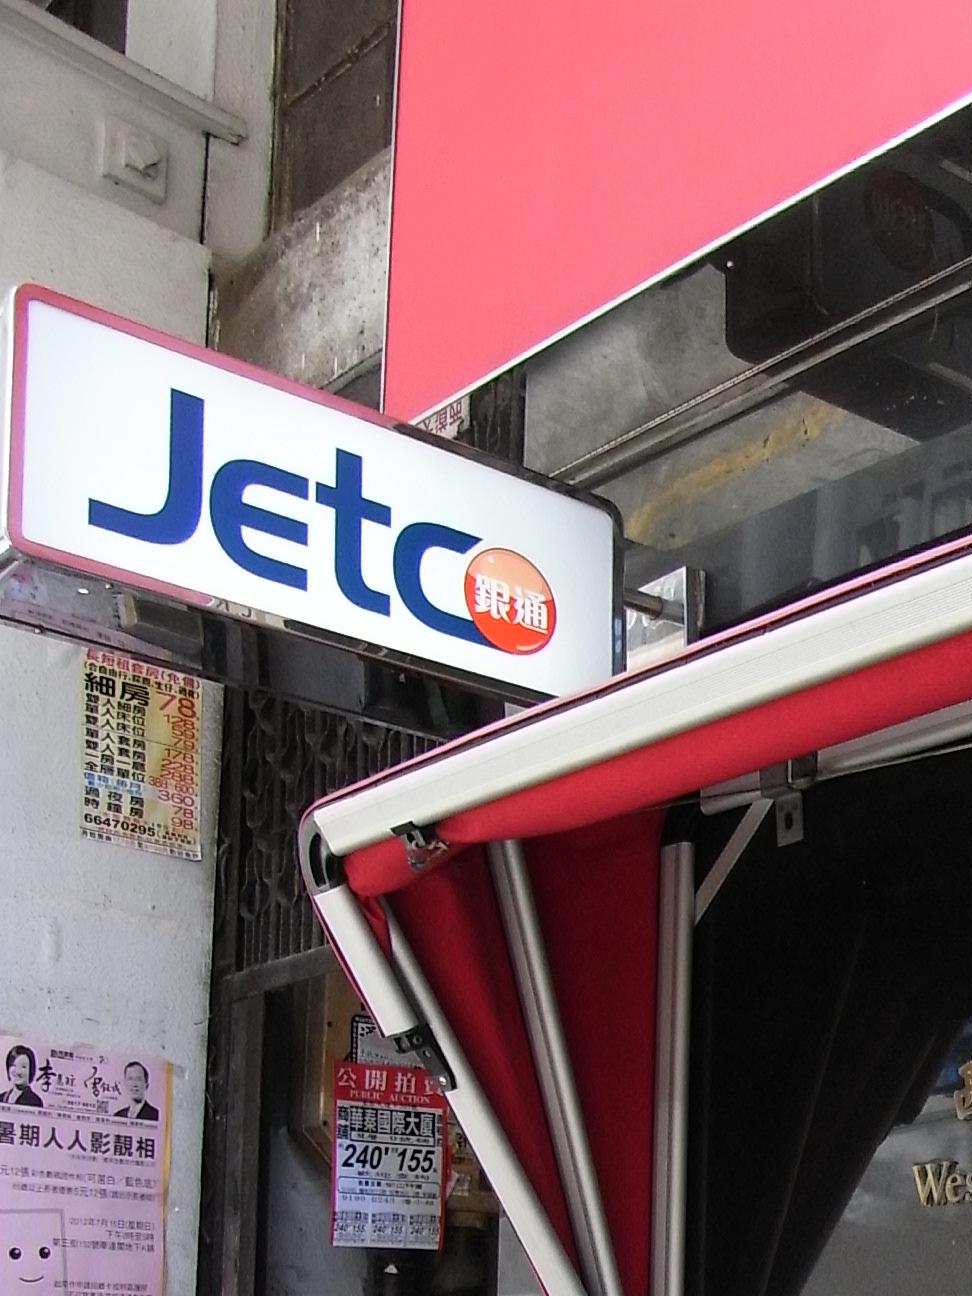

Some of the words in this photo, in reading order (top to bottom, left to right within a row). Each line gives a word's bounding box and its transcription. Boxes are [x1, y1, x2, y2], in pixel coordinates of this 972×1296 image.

[474, 572, 549, 634] 銀通
[85, 672, 150, 707] 細房
[155, 691, 197, 719] 78
[84, 813, 156, 837] 66470295
[350, 1090, 382, 1100] PUBLIC
[391, 1093, 430, 1104] AUCTION
[0, 1122, 155, 1160] 暑期人人影靚相
[397, 1148, 435, 1173] 155
